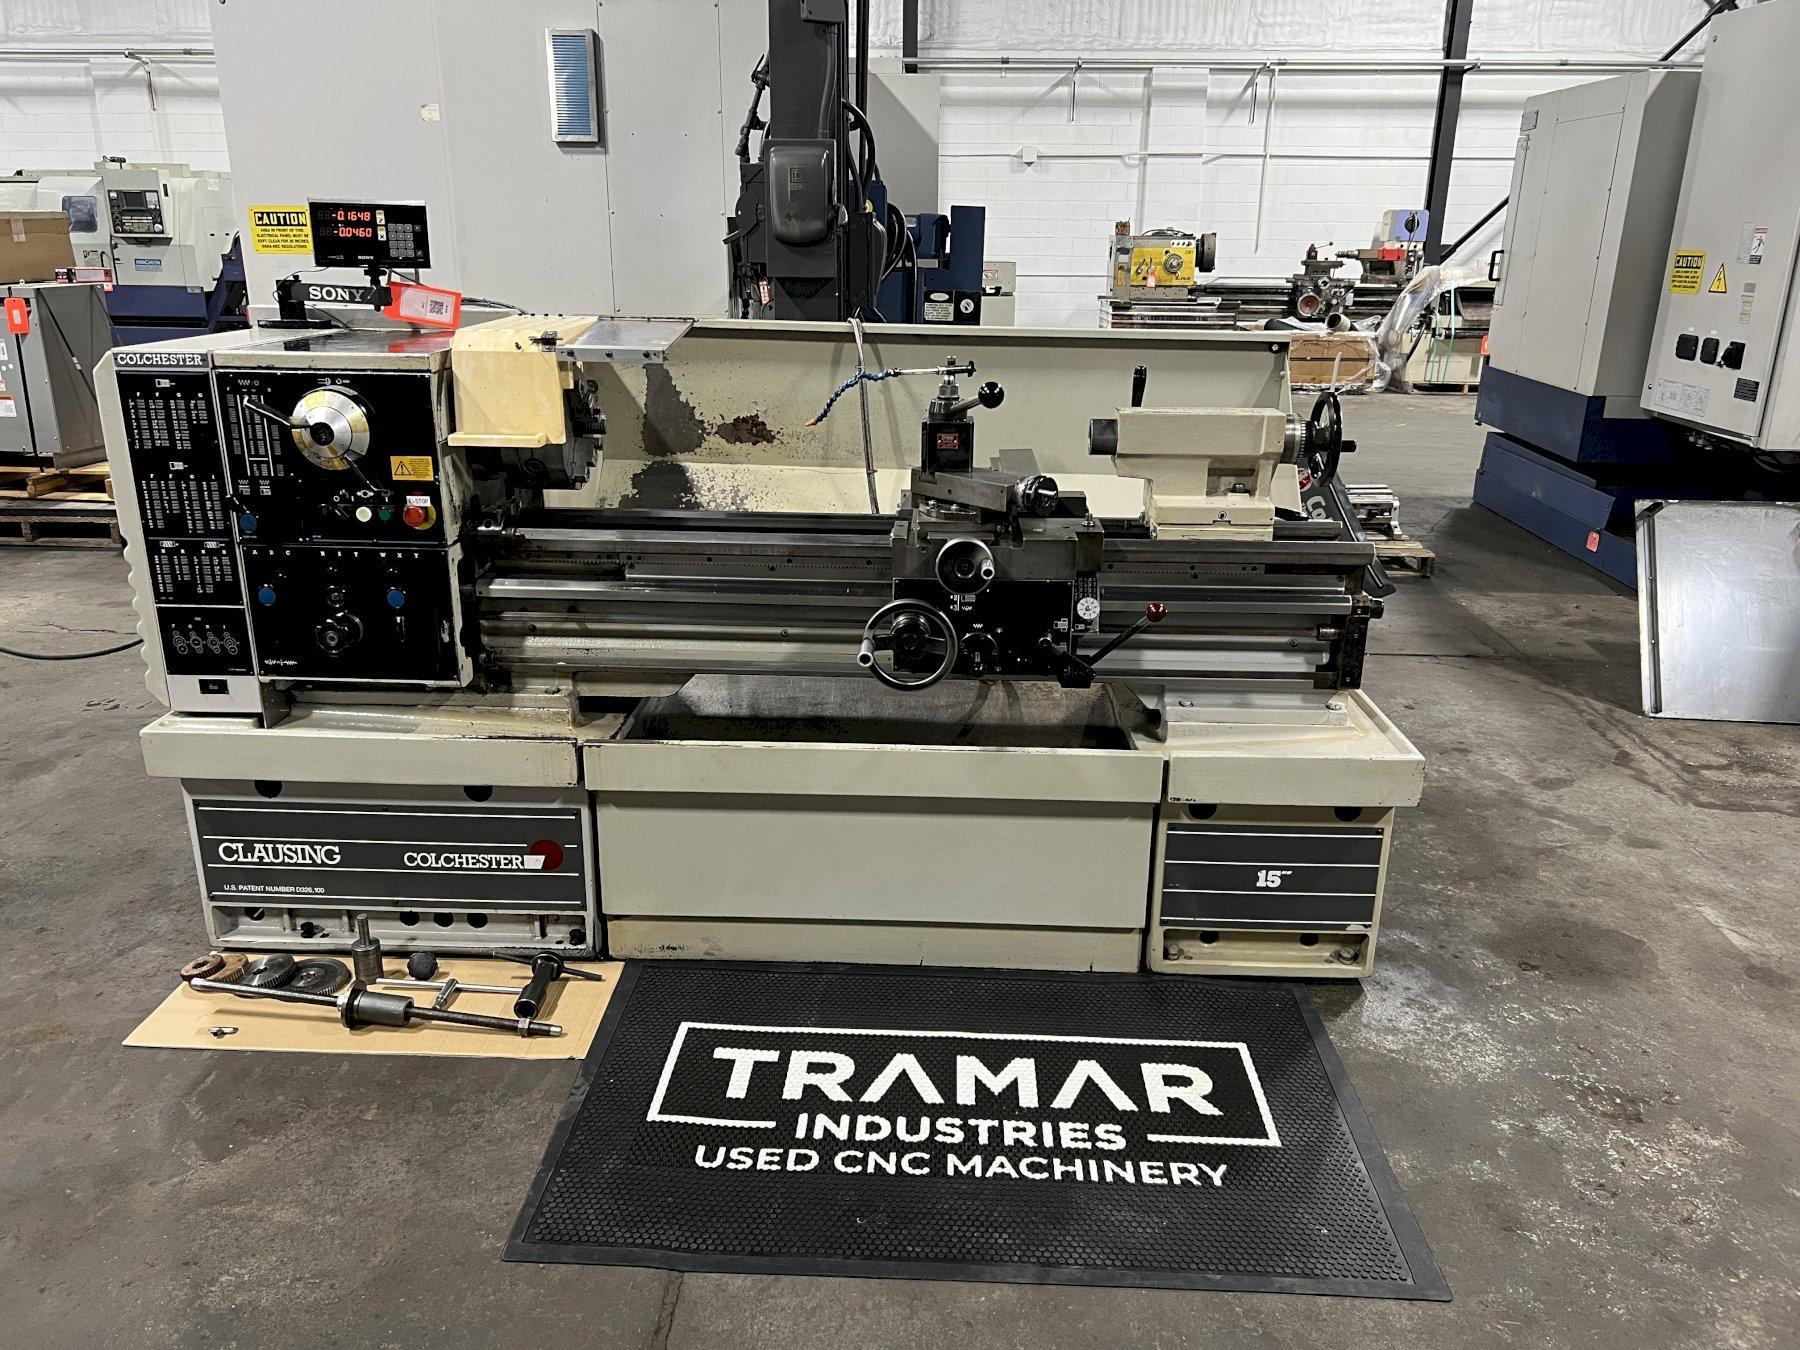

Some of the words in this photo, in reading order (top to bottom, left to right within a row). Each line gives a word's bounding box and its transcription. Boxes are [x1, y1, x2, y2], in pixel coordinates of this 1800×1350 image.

[255, 212, 307, 225] CAUTION
[1675, 256, 1701, 268] CAUTION
[308, 285, 365, 302] SONY
[117, 353, 203, 365] COLCHESTER
[218, 842, 342, 865] CLAUSING
[404, 852, 525, 869] COLCHESTER
[713, 1046, 1224, 1117] TRAMAR
[795, 1112, 1127, 1152] INDUSTRIES
[694, 1144, 820, 1173] USED
[833, 1149, 931, 1176] CNC
[947, 1153, 1229, 1188] MACHINERY
